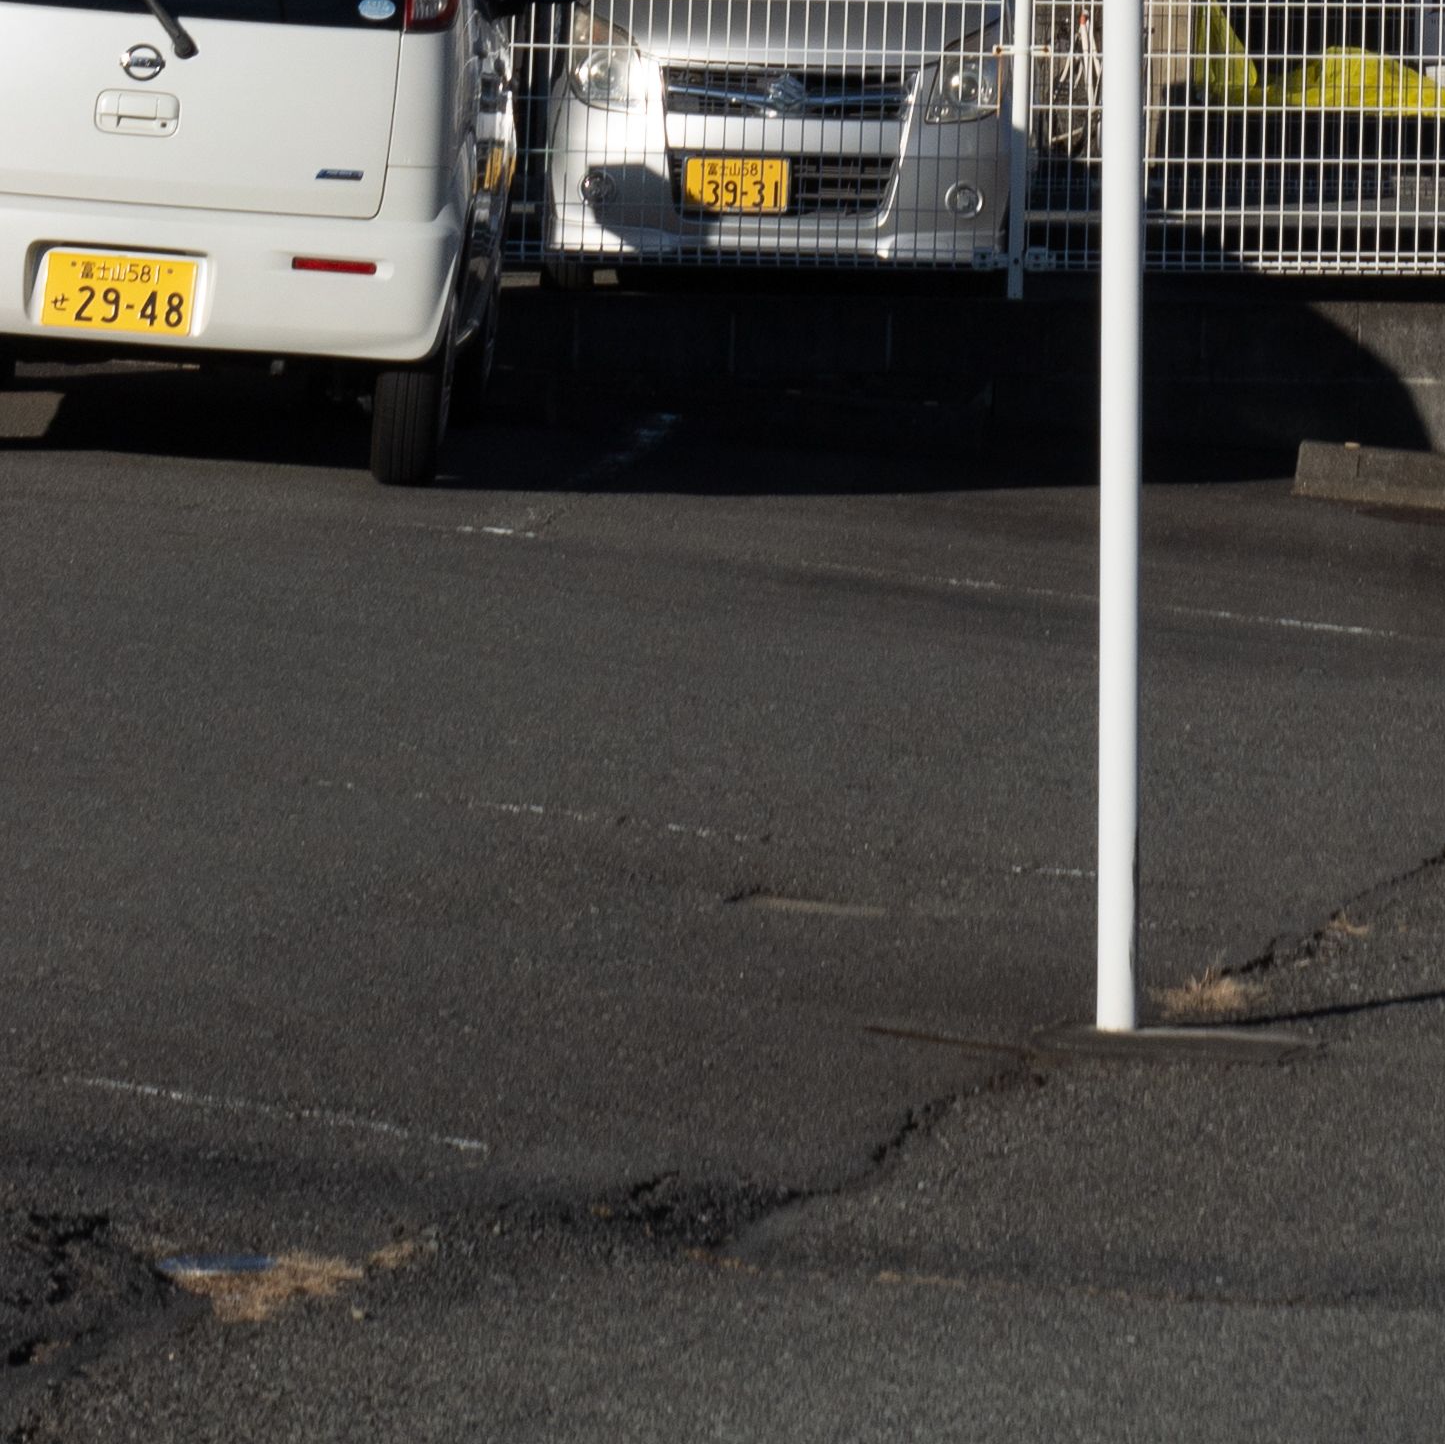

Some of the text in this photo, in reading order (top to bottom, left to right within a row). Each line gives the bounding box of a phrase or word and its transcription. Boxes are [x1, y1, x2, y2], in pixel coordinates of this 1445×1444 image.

[706, 179, 779, 208] 39-31
[51, 284, 185, 328] せ 29-48
